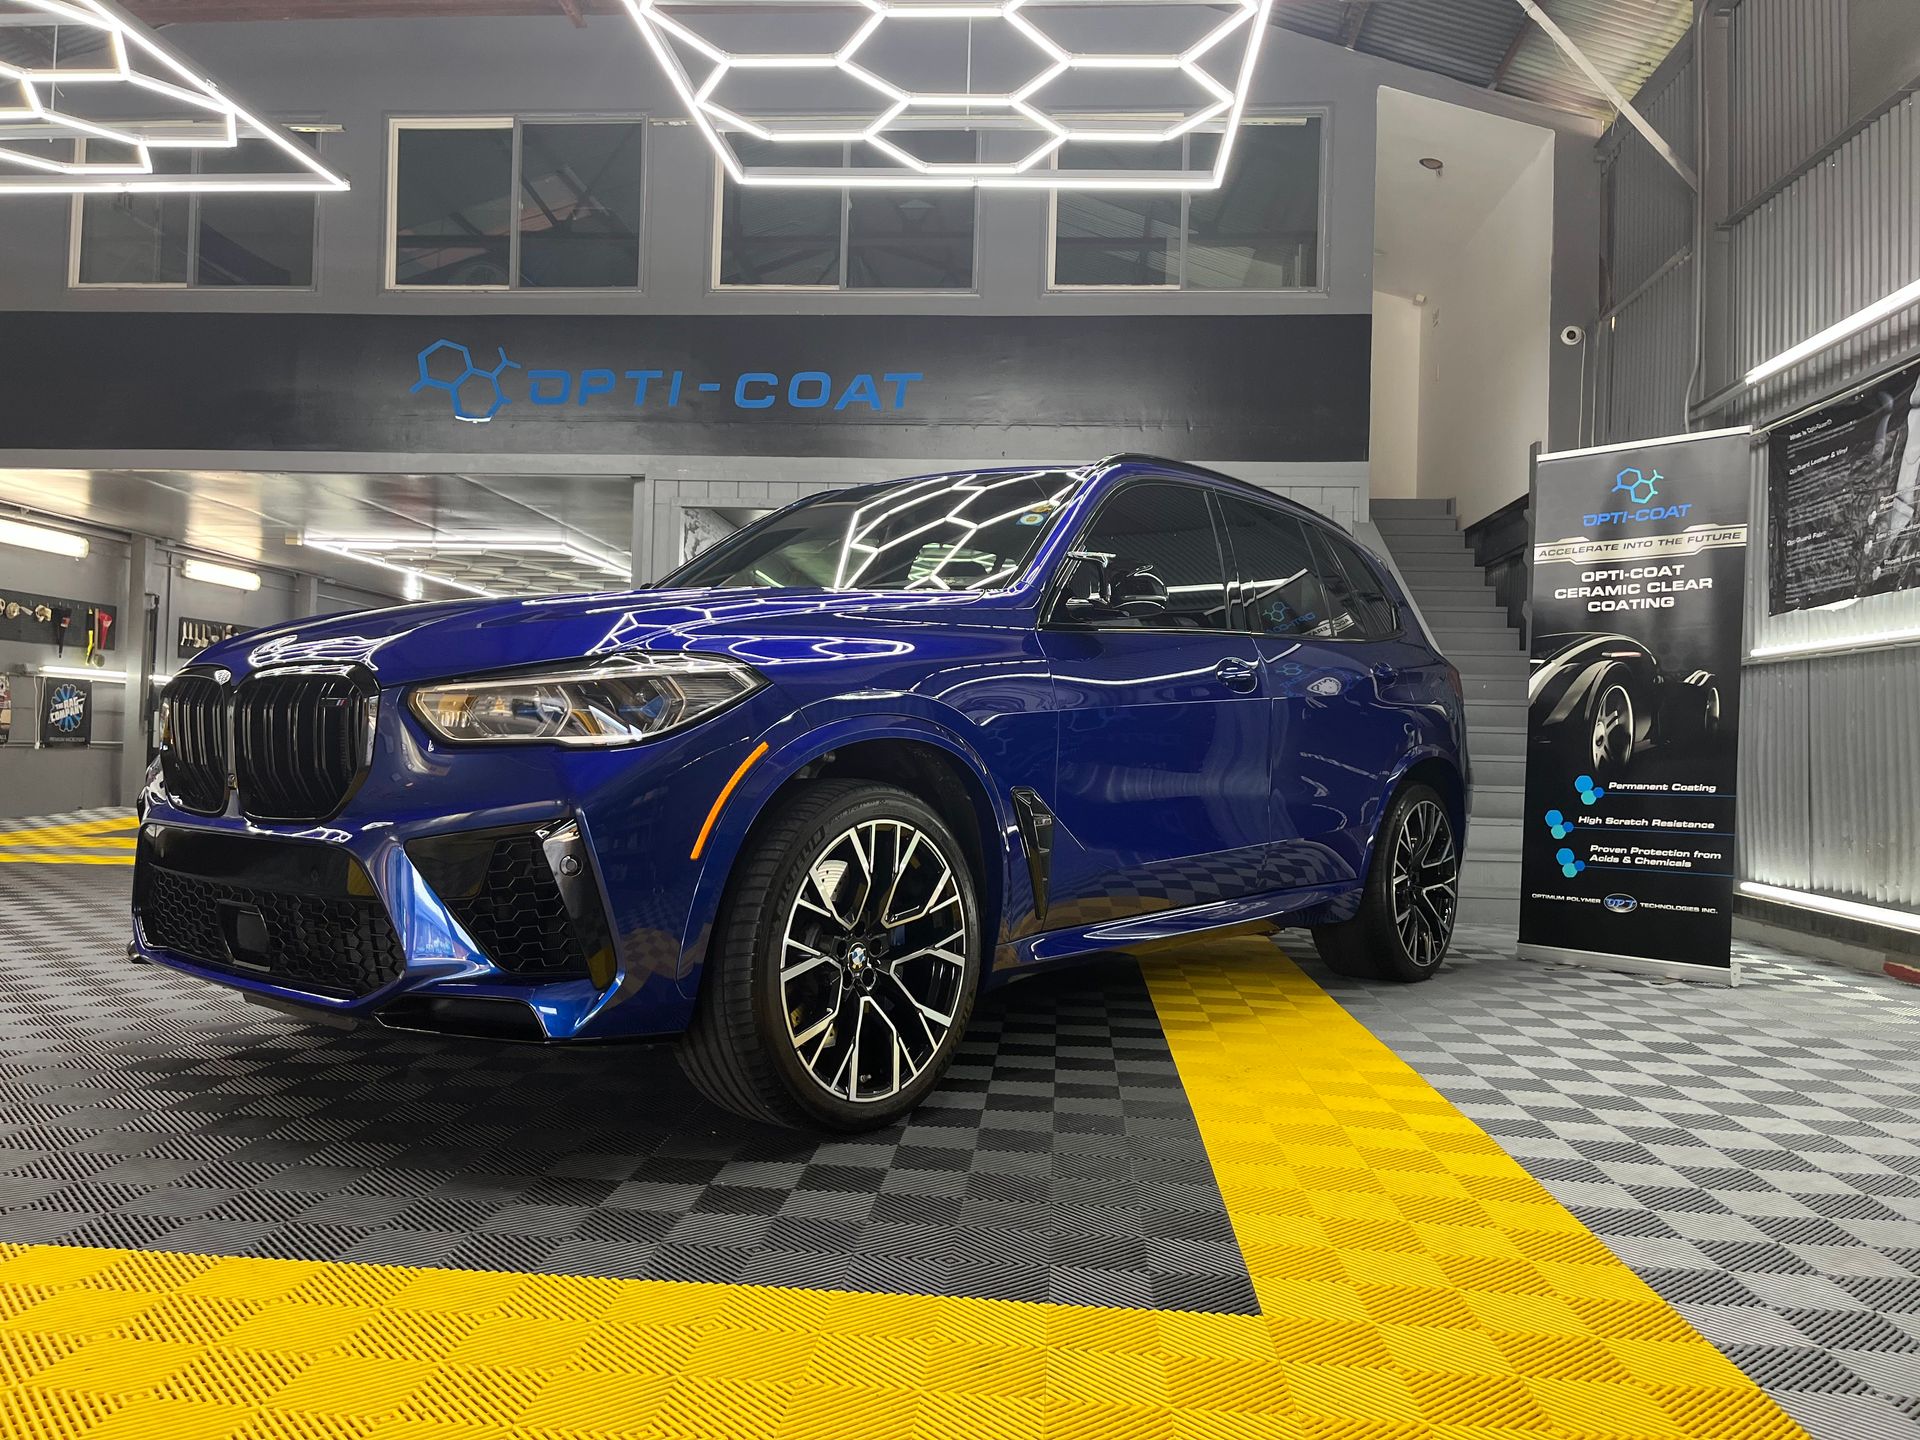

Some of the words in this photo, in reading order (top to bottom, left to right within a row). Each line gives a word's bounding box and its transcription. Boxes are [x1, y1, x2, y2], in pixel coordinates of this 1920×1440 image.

[527, 369, 923, 411] OPTI-COAT
[1583, 504, 1692, 527] OPTI-COAT
[1538, 543, 1619, 557] ACCELERATE
[1622, 540, 1653, 550] INTO
[1657, 537, 1683, 547] THE
[1687, 531, 1742, 544] FUTURE
[1581, 565, 1685, 583] OPTI-COAT
[1554, 585, 1641, 600] CERAMIC
[1646, 578, 1713, 593] CLEAR
[1587, 597, 1675, 612] COATING
[1608, 781, 1669, 791] Permanent
[1671, 783, 1717, 793] Coating
[1578, 816, 1602, 825] High
[1605, 817, 1649, 827] Scratch
[1651, 818, 1715, 829] Resistance
[1590, 845, 1627, 854] Proven
[1630, 847, 1691, 858] Protection
[1693, 850, 1722, 860] from
[1589, 854, 1620, 864] Acids
[1622, 856, 1632, 864] &
[1634, 857, 1692, 868] Chemicals
[1566, 896, 1601, 904] POLYMER
[1640, 902, 1700, 912] TECHNOLOGIES
